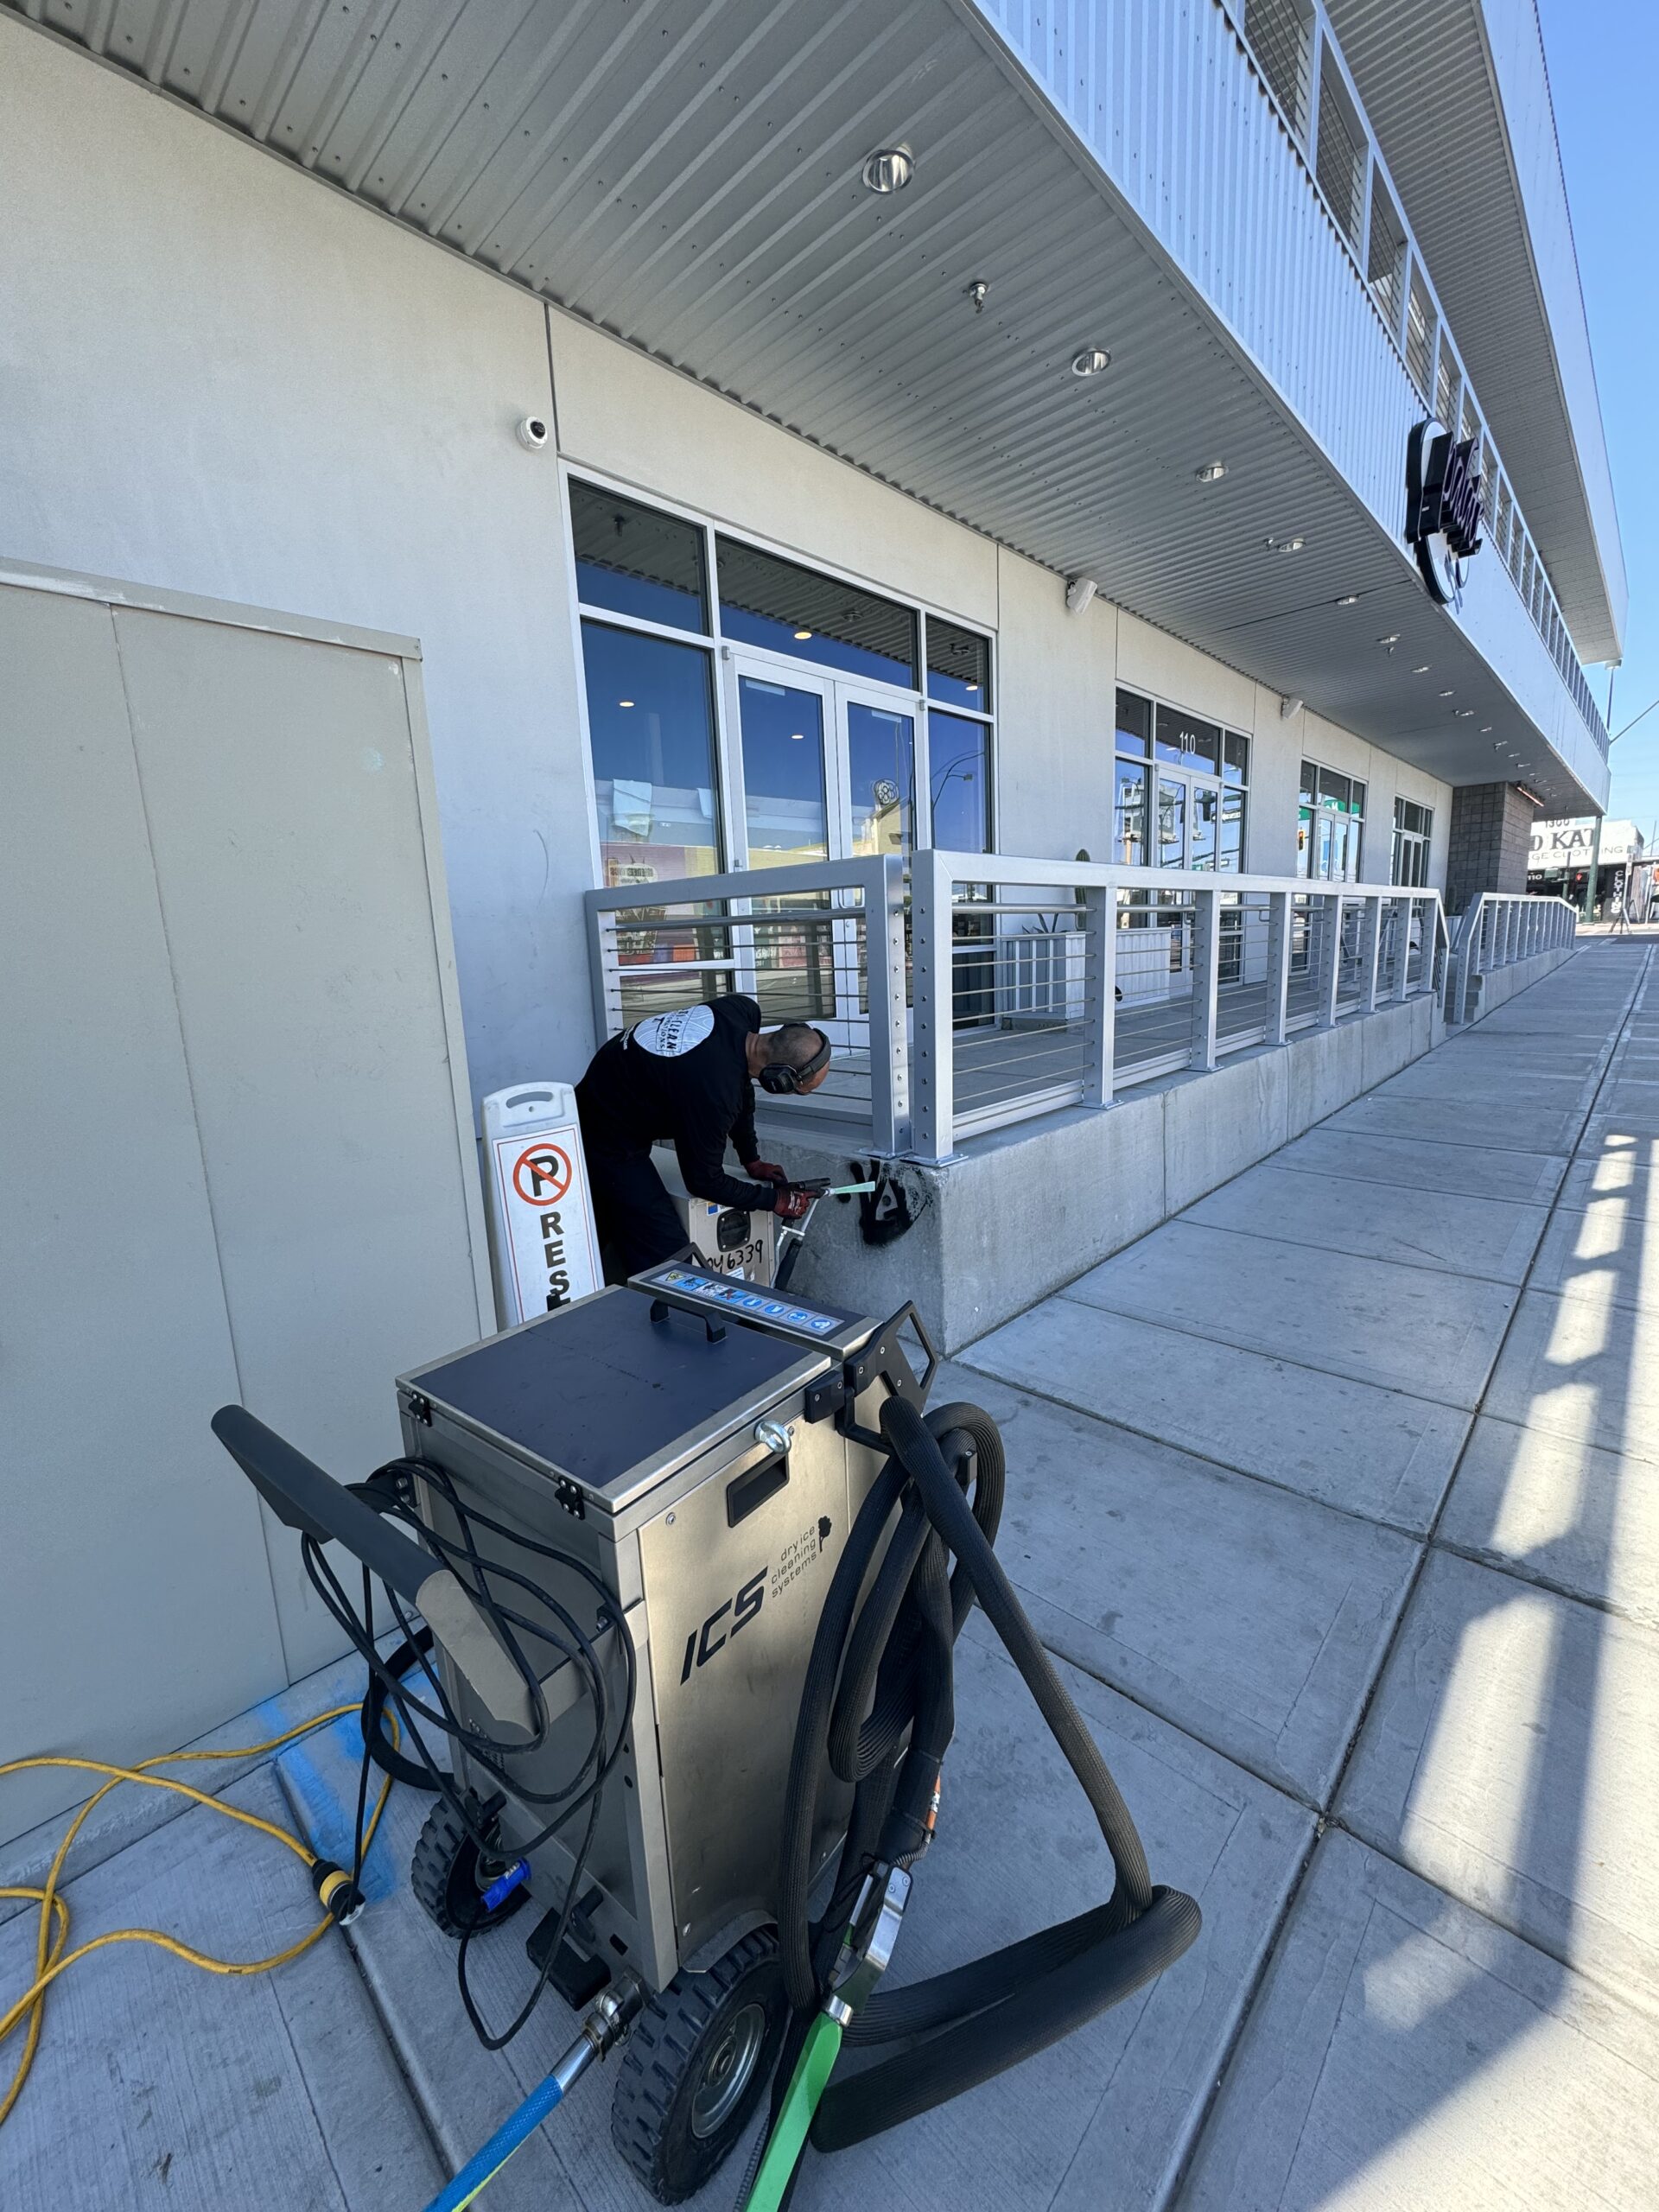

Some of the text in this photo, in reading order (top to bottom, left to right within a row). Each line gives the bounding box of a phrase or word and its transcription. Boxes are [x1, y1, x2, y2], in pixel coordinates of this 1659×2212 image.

[1179, 731, 1196, 755] 110
[1553, 846, 1624, 858] CLOTING
[771, 1538, 817, 1585] cleaning
[780, 1526, 816, 1561] dry ice
[771, 1553, 817, 1599] systems
[680, 1566, 769, 1686] ICS
